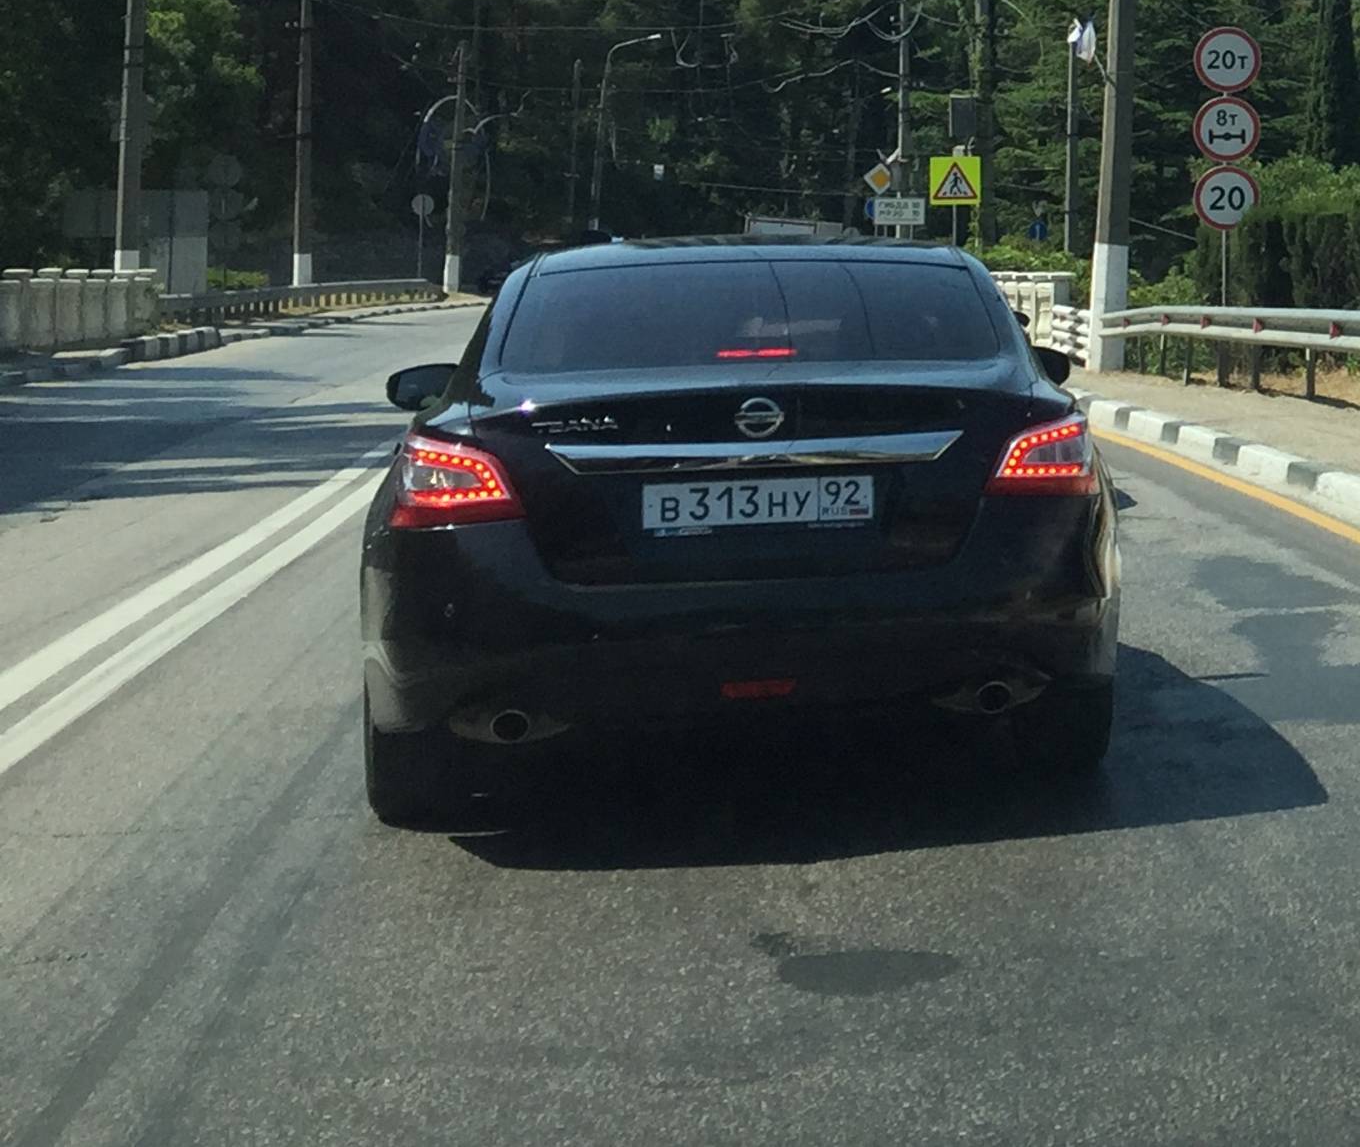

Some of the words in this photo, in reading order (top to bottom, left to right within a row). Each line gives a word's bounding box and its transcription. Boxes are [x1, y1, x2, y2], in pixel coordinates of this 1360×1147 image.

[1209, 185, 1246, 211] 20
[824, 479, 860, 506] 92
[821, 505, 849, 516] RUS
